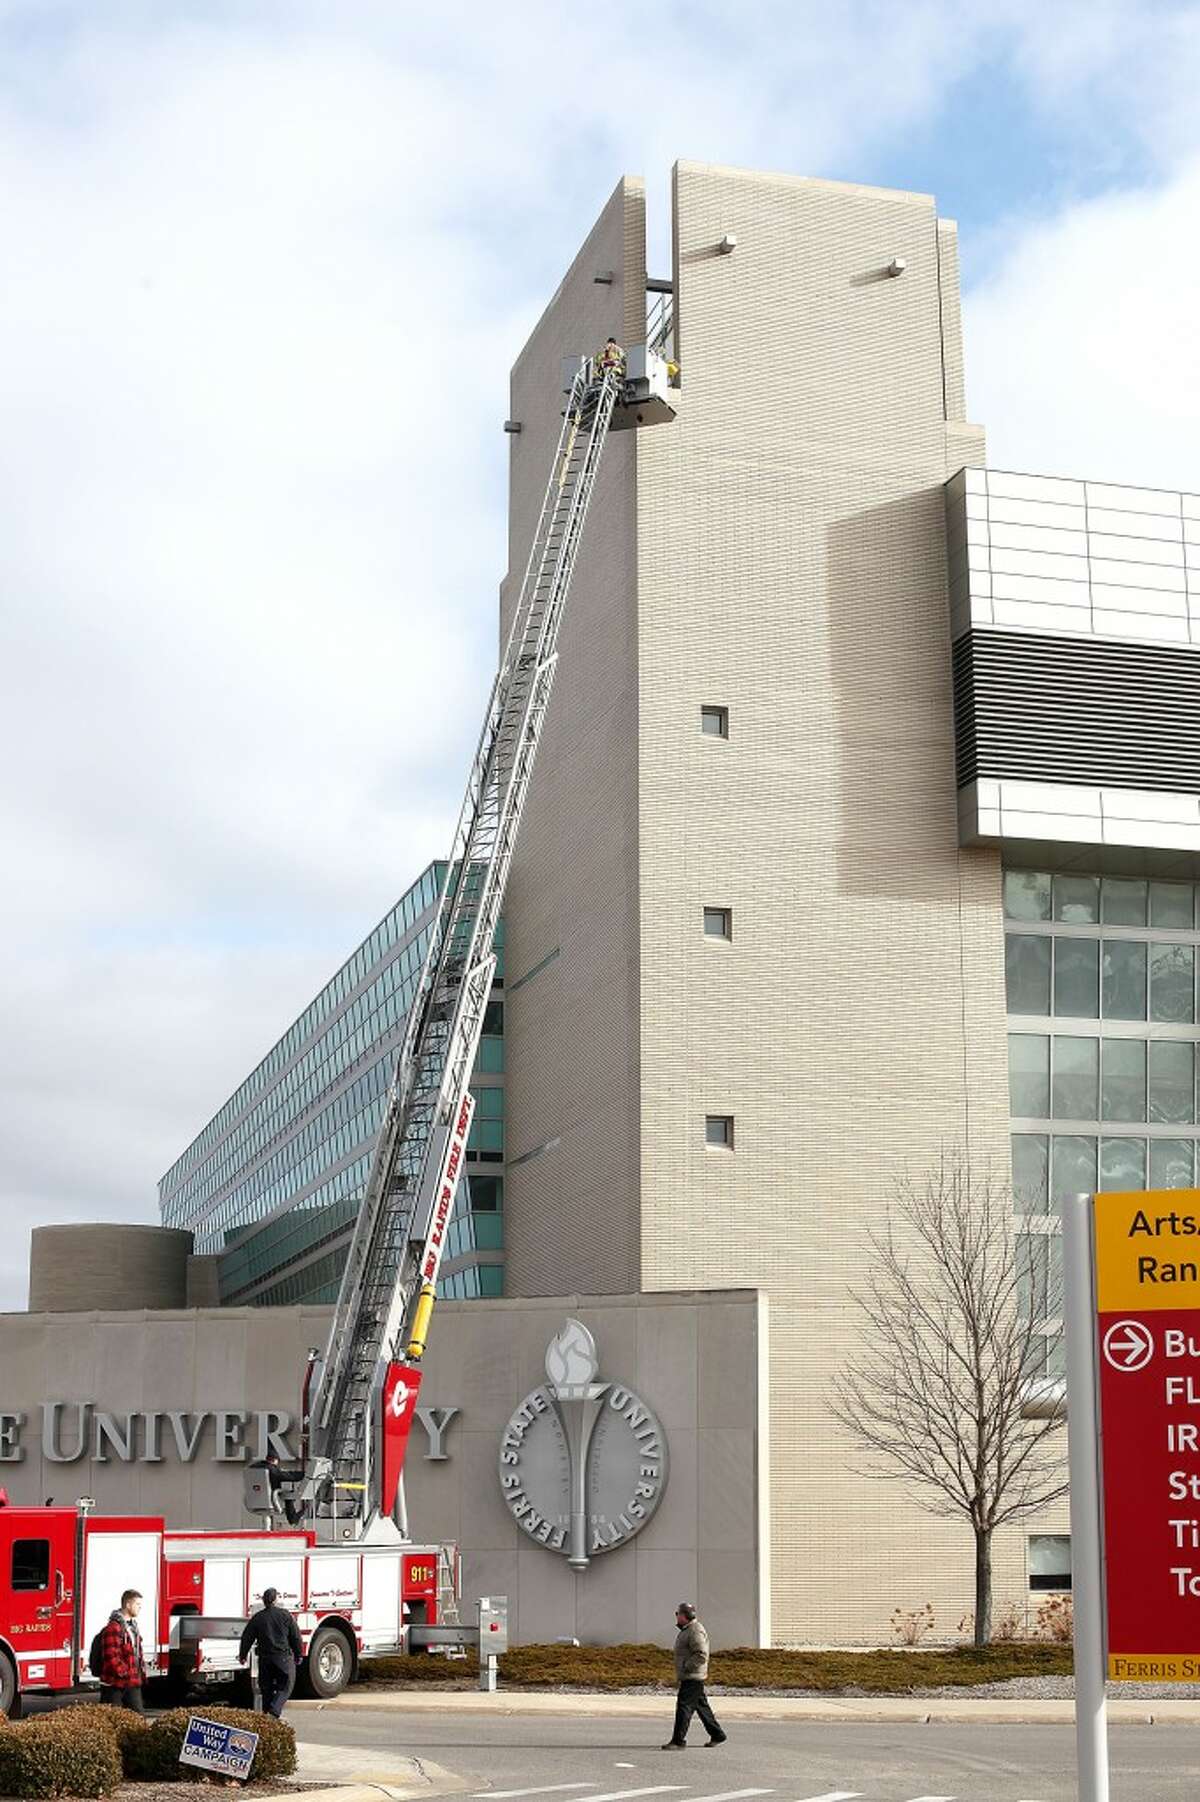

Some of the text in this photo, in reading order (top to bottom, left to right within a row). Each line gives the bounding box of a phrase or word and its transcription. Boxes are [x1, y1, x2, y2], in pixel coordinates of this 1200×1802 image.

[423, 1250, 437, 1281] BIG
[432, 1185, 452, 1248] RAPIDS
[447, 1142, 462, 1182] FIRE
[502, 1395, 549, 1465] STATE
[592, 1389, 660, 1550] UNIVERSITY
[502, 1472, 568, 1549] FERRIS
[410, 1566, 428, 1582] 911
[1114, 1659, 1177, 1677] FERRIS
[191, 1720, 228, 1740] United
[203, 1735, 225, 1754] Way
[184, 1745, 249, 1772] CAMPAIGN
